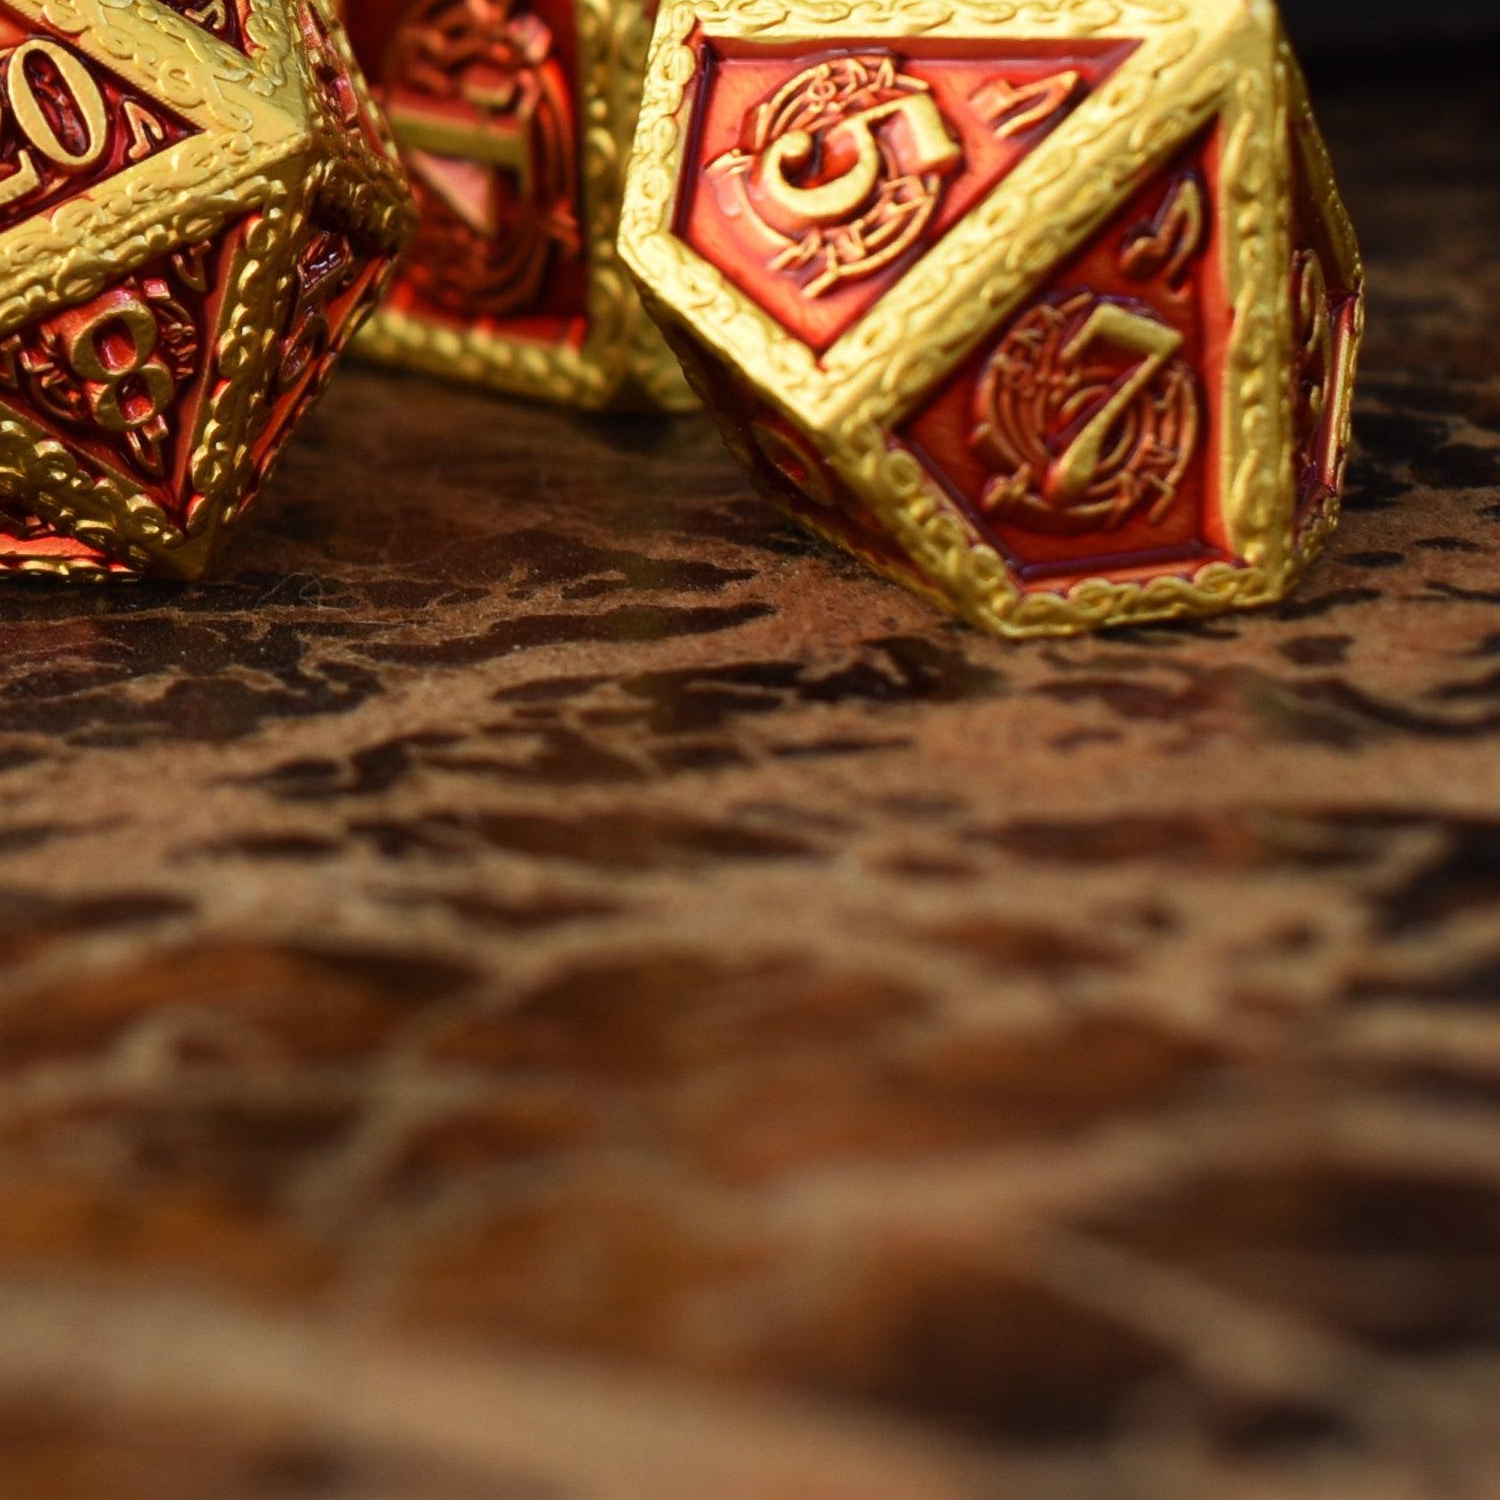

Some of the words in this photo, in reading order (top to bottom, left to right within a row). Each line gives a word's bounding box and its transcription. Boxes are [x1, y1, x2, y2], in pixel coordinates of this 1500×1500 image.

[766, 95, 959, 218] 5
[68, 296, 175, 429] 8
[1054, 303, 1183, 498] 7
